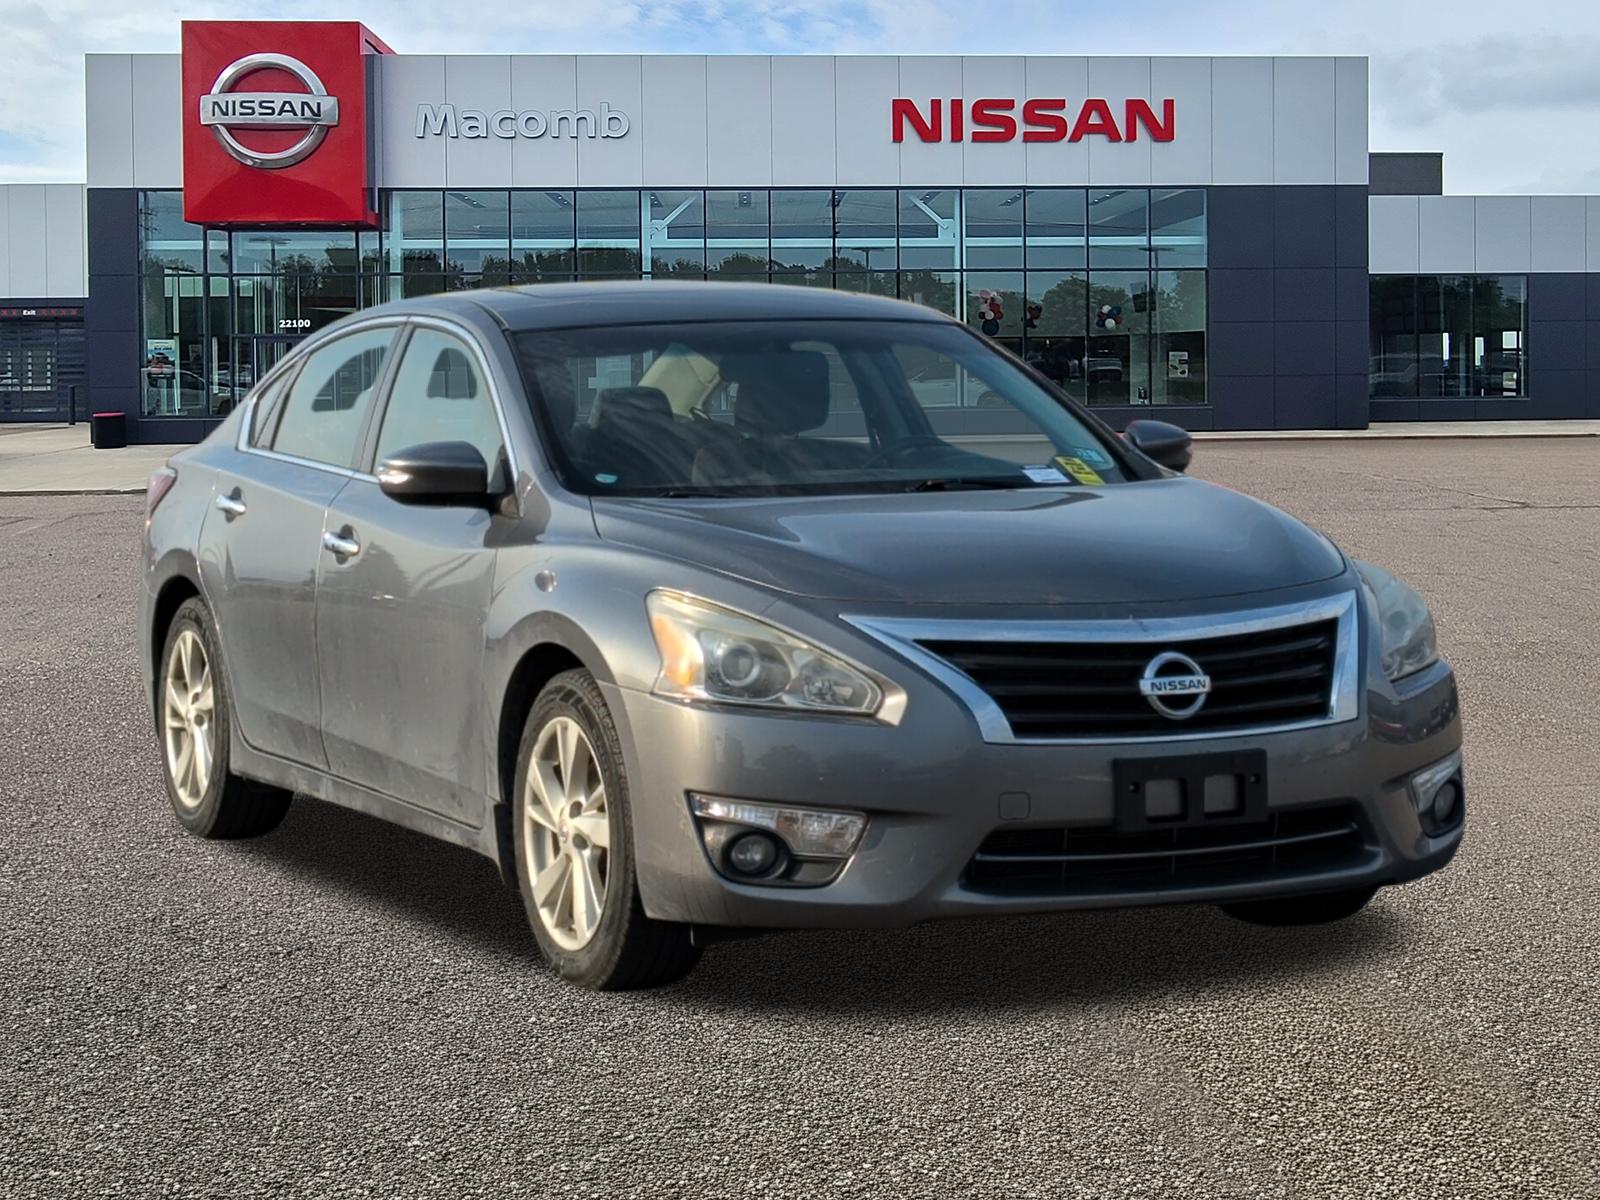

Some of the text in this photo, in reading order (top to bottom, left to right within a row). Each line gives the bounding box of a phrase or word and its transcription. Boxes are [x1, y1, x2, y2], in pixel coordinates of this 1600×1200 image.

[211, 100, 322, 118] NISSAN
[415, 102, 630, 139] Macomb
[892, 98, 1175, 143] NISSAN
[279, 319, 311, 328] 22100
[1150, 679, 1207, 692] NISSAN
